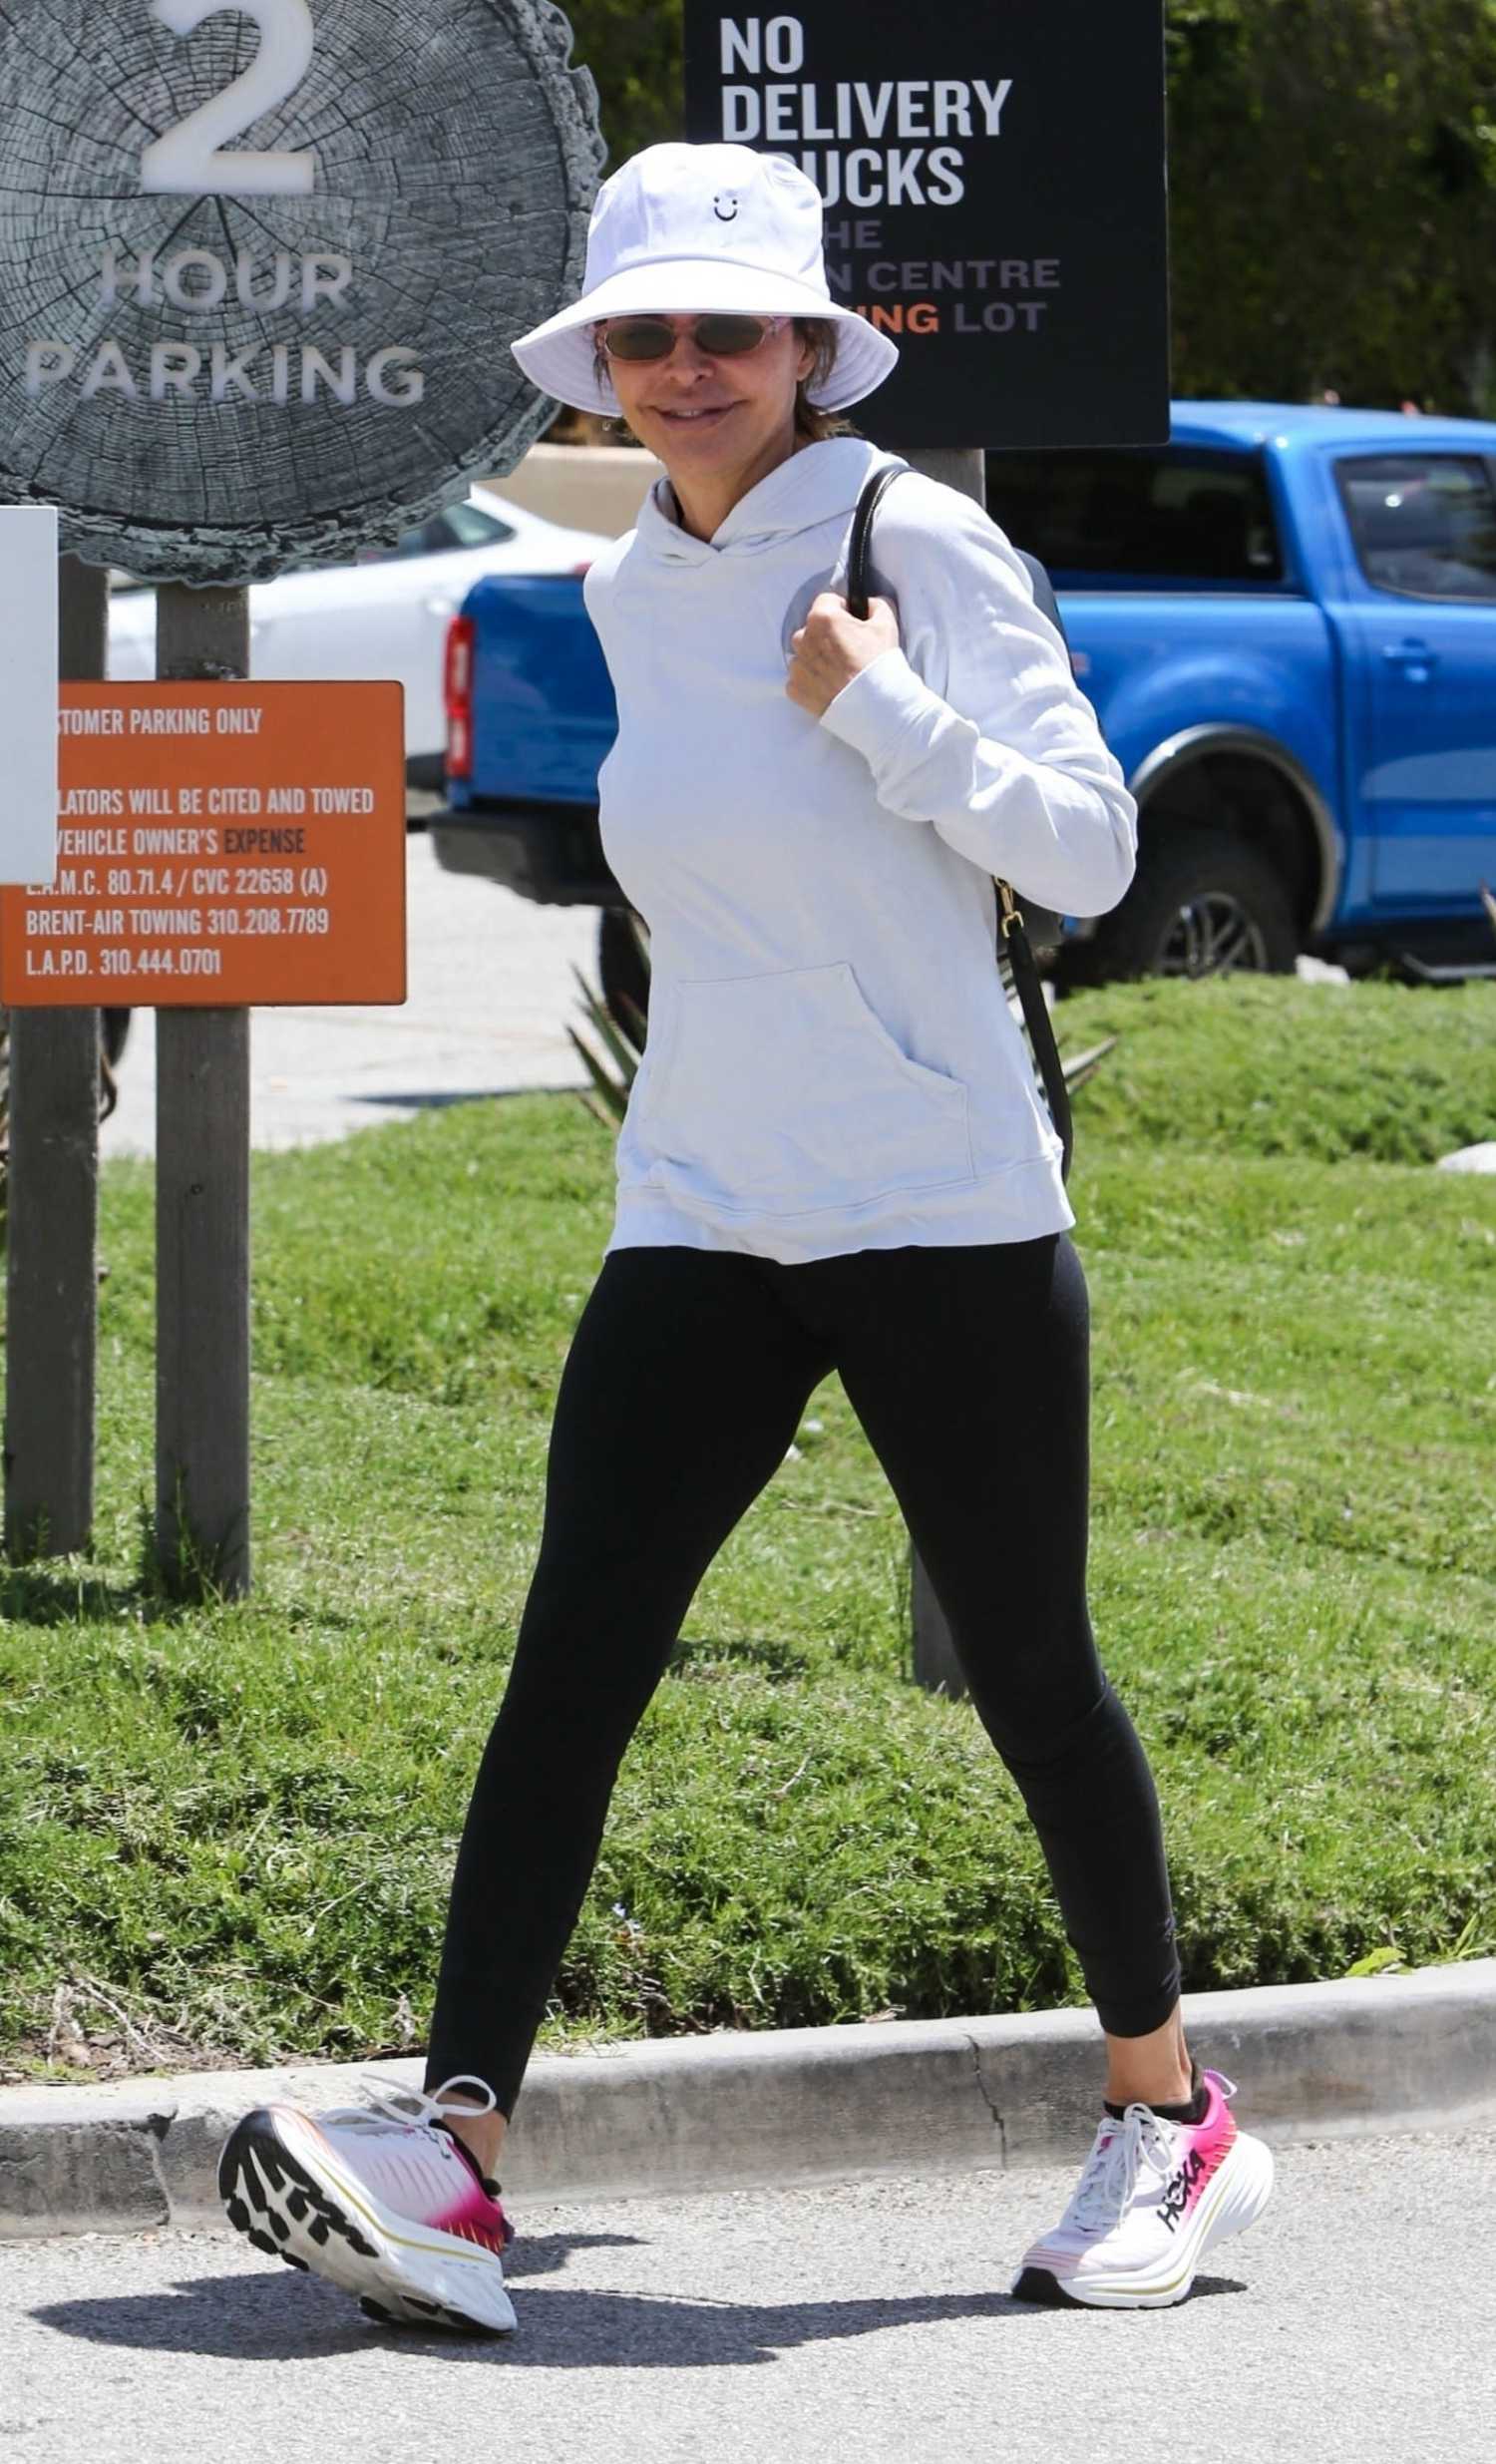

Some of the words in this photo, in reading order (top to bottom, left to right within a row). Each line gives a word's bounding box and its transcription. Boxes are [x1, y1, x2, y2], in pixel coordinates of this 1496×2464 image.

[719, 16, 805, 75] NO
[141, 0, 314, 195] 2
[721, 79, 1013, 142] DELIVERY
[774, 147, 964, 208] UCKS
[823, 219, 883, 249] HE
[101, 249, 352, 311] HOUR
[866, 259, 1062, 292] CENTRE
[953, 302, 1047, 333] LOT
[24, 340, 426, 408] PARKING
[58, 709, 124, 735] TOMER
[130, 708, 209, 734] PARKING
[216, 708, 262, 734] ONLY
[57, 789, 124, 815] LATORS
[129, 789, 173, 815] WILL
[180, 789, 202, 815] BE
[208, 789, 260, 815] CITED
[266, 788, 305, 814] AND
[311, 788, 374, 814] TOWED
[224, 828, 305, 854] EXPENSE
[107, 870, 173, 896] 80.71.4
[178, 870, 188, 897] /
[192, 870, 228, 895] CVC
[234, 870, 294, 895] 22658
[300, 868, 328, 897] (A)
[26, 910, 124, 936] BRENT-AIR
[131, 910, 201, 935] TOWING
[206, 909, 329, 935] 310.208.7789
[26, 950, 94, 976] L.A.P.D.
[100, 950, 221, 976] 310.444.0701
[1156, 2148, 1206, 2233] HOKA
